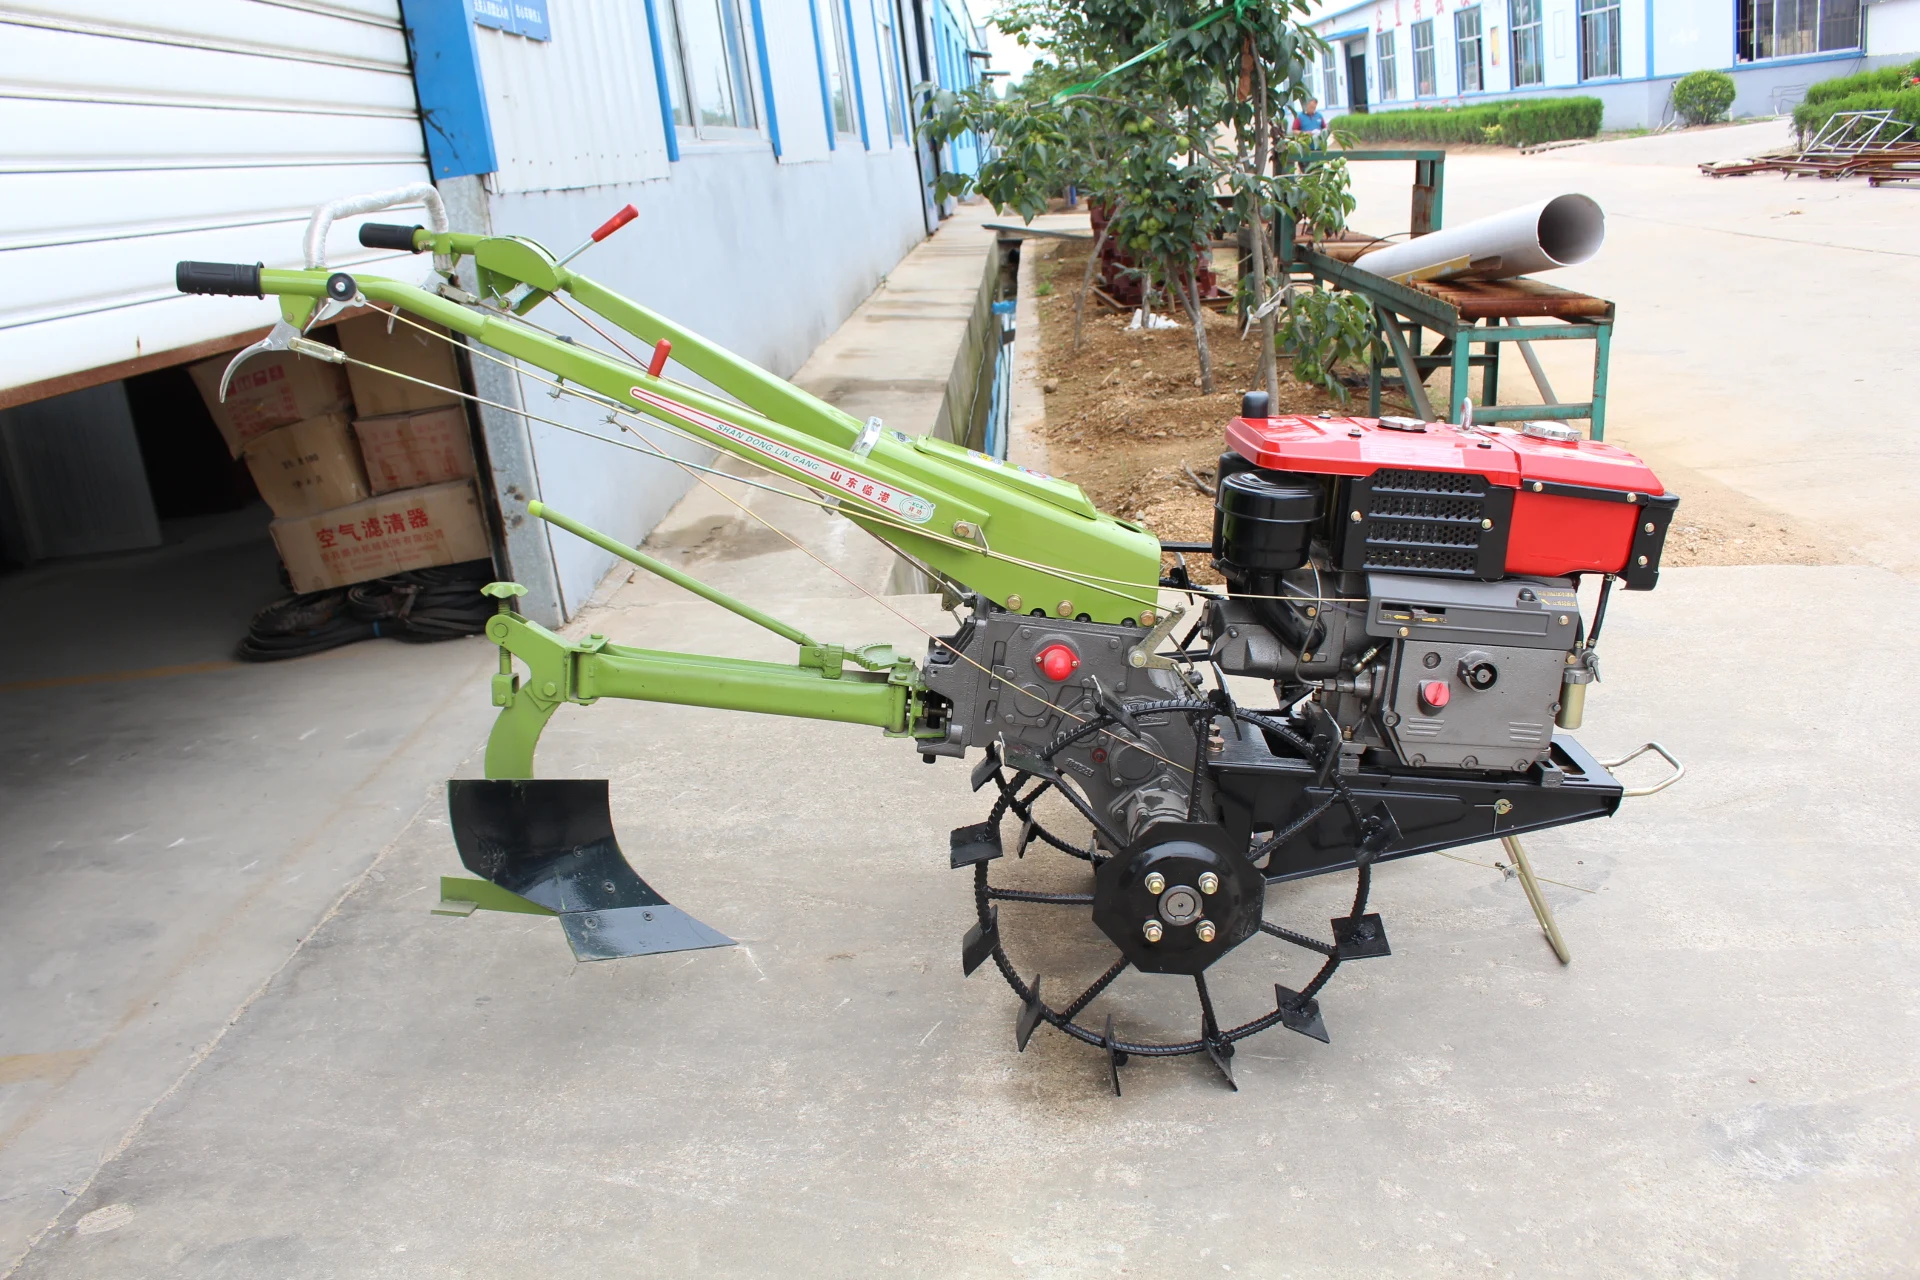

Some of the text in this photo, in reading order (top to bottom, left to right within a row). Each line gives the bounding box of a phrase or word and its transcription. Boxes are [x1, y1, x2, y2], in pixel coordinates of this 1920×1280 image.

[716, 424, 820, 470] SHAN DONG LIN GANG
[829, 470, 892, 503] 山东临港
[316, 507, 429, 549] 空气滤清器
